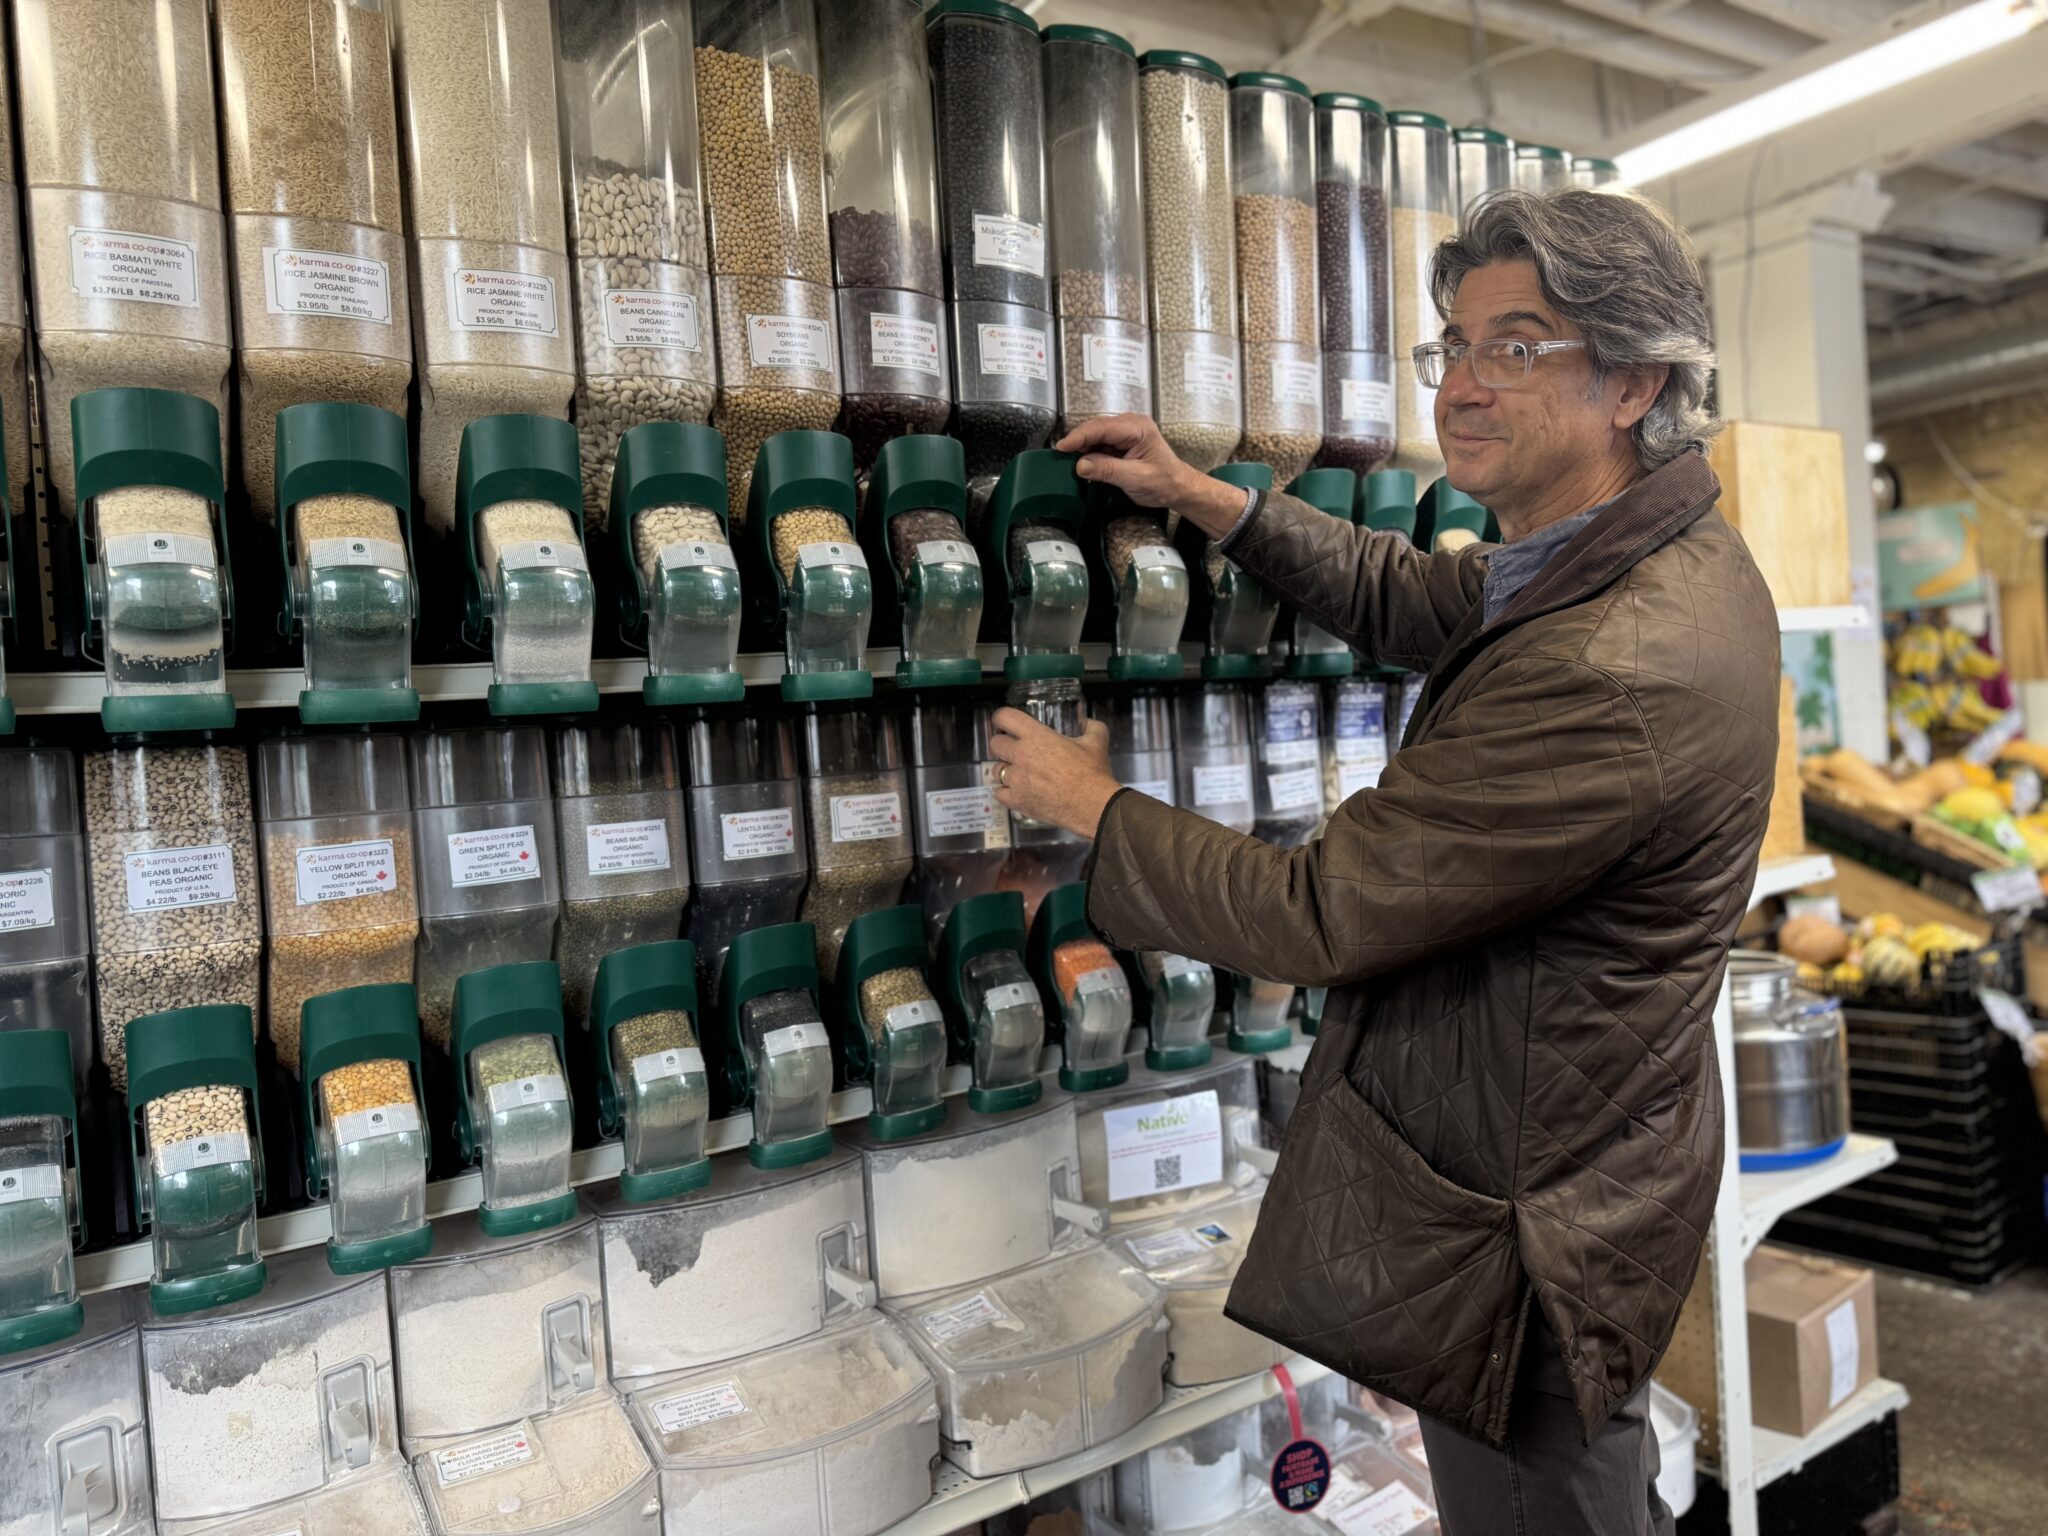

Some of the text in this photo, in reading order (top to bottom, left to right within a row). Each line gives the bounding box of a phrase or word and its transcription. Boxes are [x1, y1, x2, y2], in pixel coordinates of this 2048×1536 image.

[98, 239, 131, 250] karma
[84, 251, 182, 270] RICE BASMATI WHITE
[300, 258, 330, 267] karma
[113, 265, 157, 276] ORGANIC
[98, 274, 128, 282] PRODUCT
[142, 279, 172, 288] PAKISTAN
[285, 270, 379, 287] RICE JASMINE BROWN
[477, 276, 504, 284] karma
[314, 283, 354, 293] ORGANIC
[140, 289, 180, 301] $8.29/KG
[488, 288, 521, 297] JASMINE
[523, 292, 545, 301] WHITE
[341, 297, 368, 305] THAILAND
[491, 299, 526, 308] ORGANIC
[297, 302, 372, 317] $3.95/lb $8.69/kg
[647, 309, 685, 318] CANNELLINI
[515, 319, 542, 329] $8.69/kg
[639, 318, 671, 326] ORGANIC
[464, 836, 489, 844] karma
[459, 847, 485, 855] GREEN
[613, 844, 644, 852] ORGANIC
[147, 857, 176, 866] karma
[318, 853, 345, 861] karma
[478, 852, 510, 861] ORGANIC
[142, 863, 219, 878] BEANS BLACK EYE
[309, 859, 385, 873] YELLOW SPLIT PEAS
[332, 871, 367, 880] ORGANIC
[465, 871, 491, 879] $2.04/lb
[149, 874, 214, 887] PEAS ORGANIC
[318, 886, 384, 899] $2.22/lb $4.89/kg
[146, 892, 220, 905] $4.22/lb $9.29/kg
[2, 918, 36, 927] $7.09/kg
[1137, 1113, 1189, 1132] Native
[695, 1398, 716, 1406] FLOUR
[472, 1448, 492, 1457] HARD
[494, 1441, 516, 1453] BREAD
[458, 1448, 515, 1466] FLOUR ORGANIC
[1287, 1448, 1313, 1463] SHOP
[1282, 1456, 1319, 1473] FAIRTRADE
[1295, 1467, 1314, 1476] MAKE
[1284, 1469, 1325, 1487] DIFFERENCE
